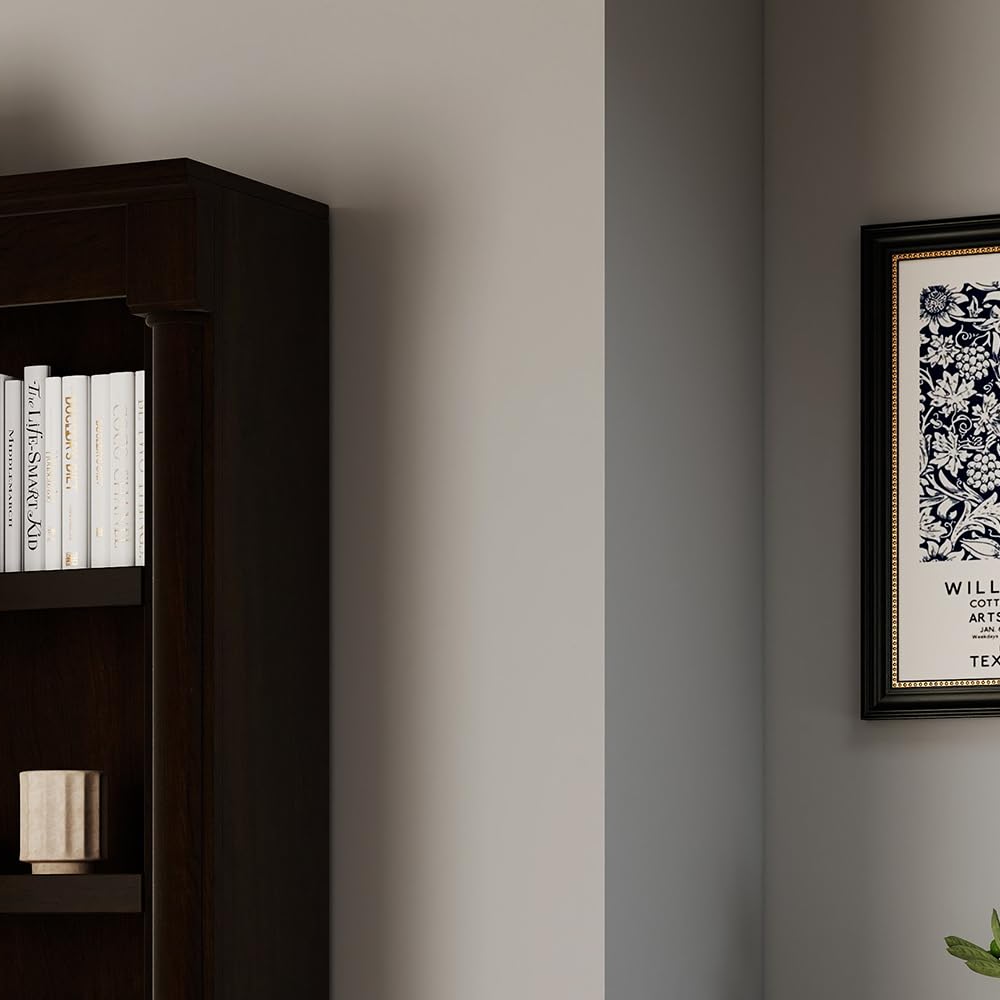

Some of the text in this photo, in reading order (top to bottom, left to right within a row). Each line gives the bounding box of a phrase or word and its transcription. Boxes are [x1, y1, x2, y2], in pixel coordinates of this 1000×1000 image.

[28, 380, 42, 409] The
[7, 429, 15, 528] MIDDLEMARCH
[944, 580, 1000, 595] WILL
[969, 598, 1000, 608] COTT
[968, 612, 1000, 623] ARTS
[969, 655, 1000, 668] TEX
